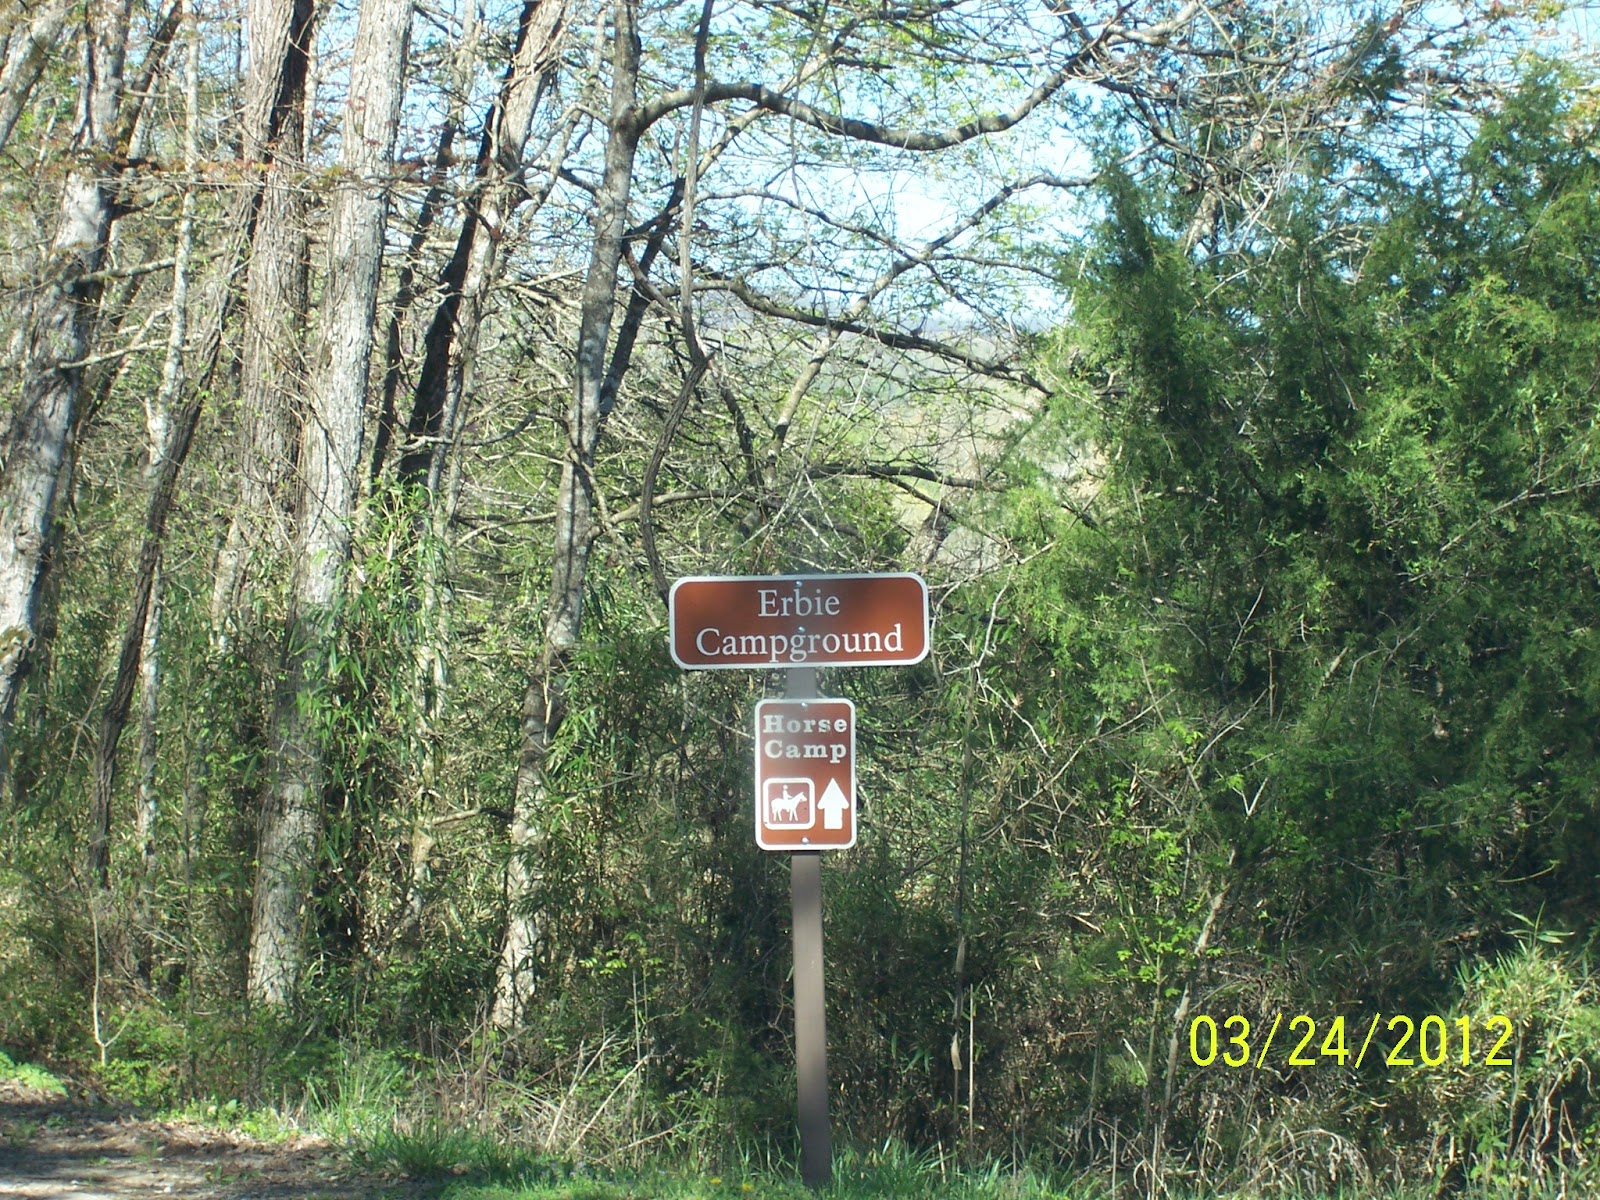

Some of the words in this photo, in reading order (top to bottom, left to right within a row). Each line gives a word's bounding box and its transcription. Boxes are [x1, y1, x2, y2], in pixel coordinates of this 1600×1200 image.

[757, 588, 840, 617] Erbie
[696, 623, 904, 663] Campground
[762, 714, 848, 734] Horse
[763, 739, 847, 763] Camp
